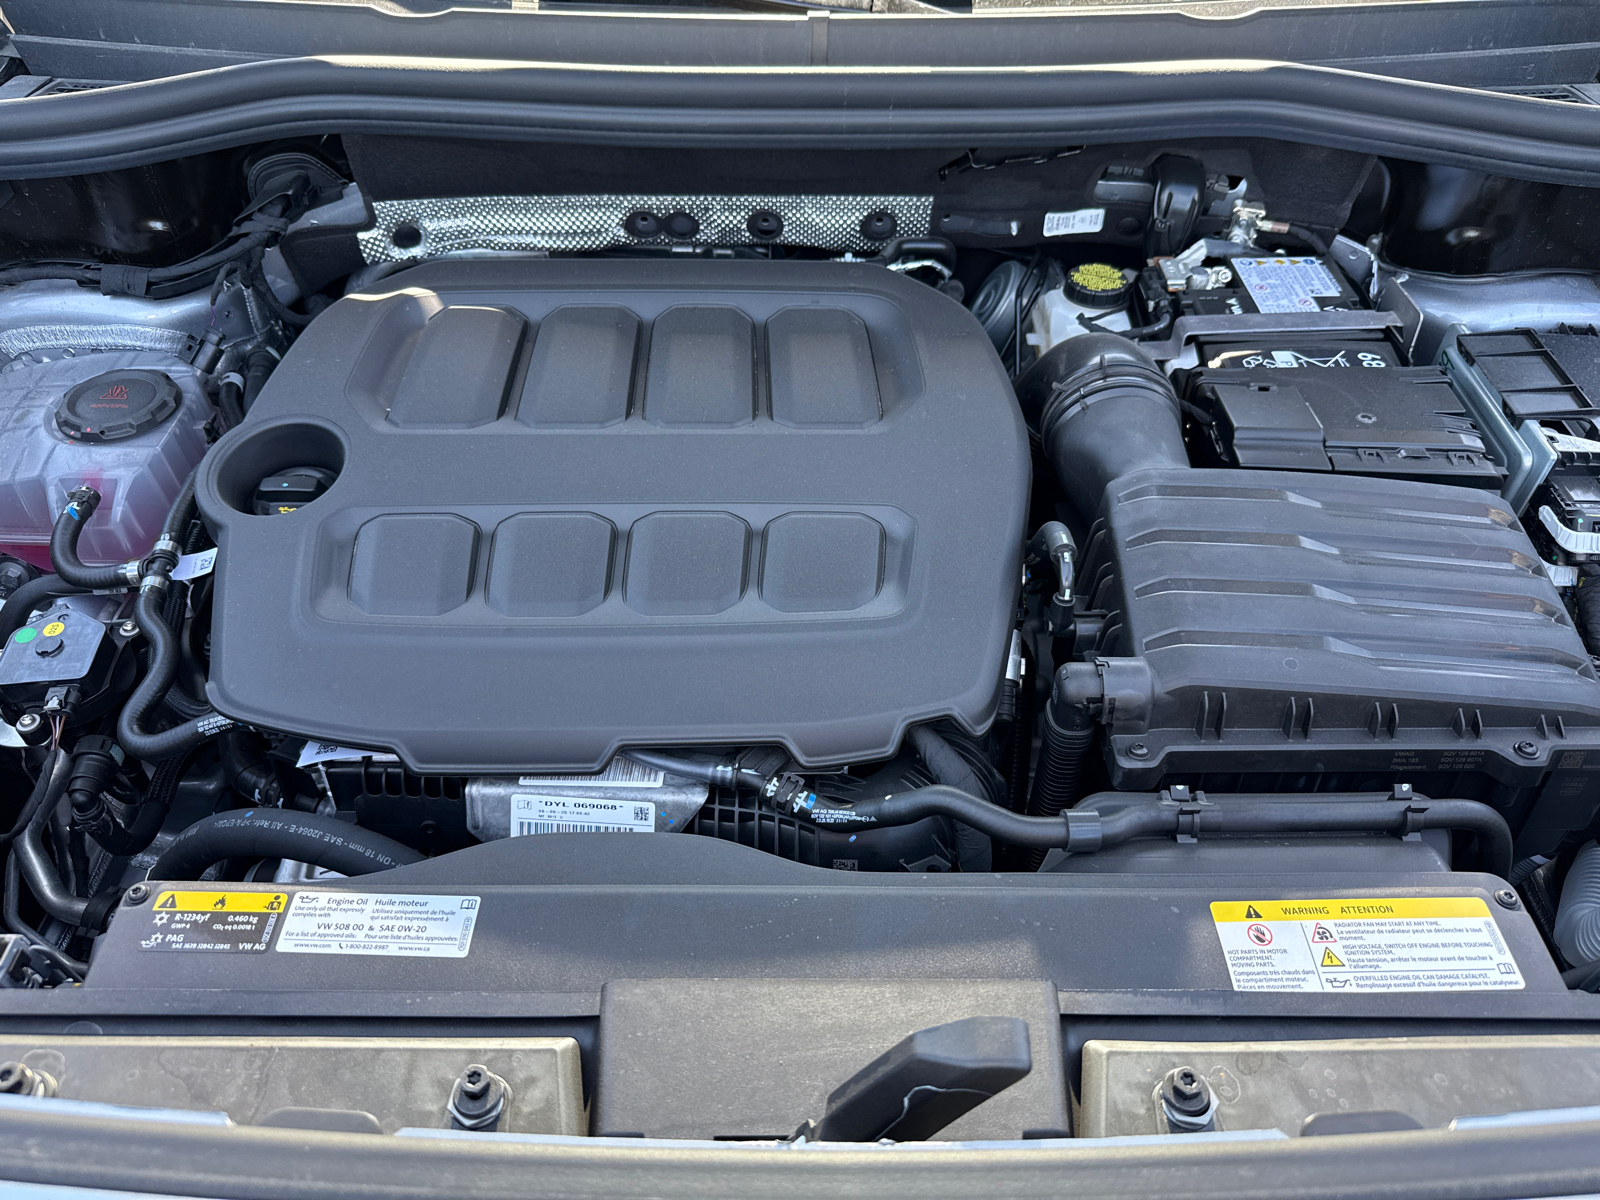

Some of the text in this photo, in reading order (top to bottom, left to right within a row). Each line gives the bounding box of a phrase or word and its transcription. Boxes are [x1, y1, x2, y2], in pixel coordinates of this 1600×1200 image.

[289, 824, 323, 839] J2064-E
[323, 833, 344, 846] SAE
[348, 842, 365, 853] mm
[364, 848, 376, 858] 18
[377, 853, 391, 865] DN
[327, 898, 355, 906] Engine
[1281, 906, 1394, 915] WARNING ATTENTION
[174, 913, 211, 923] R-1234yf
